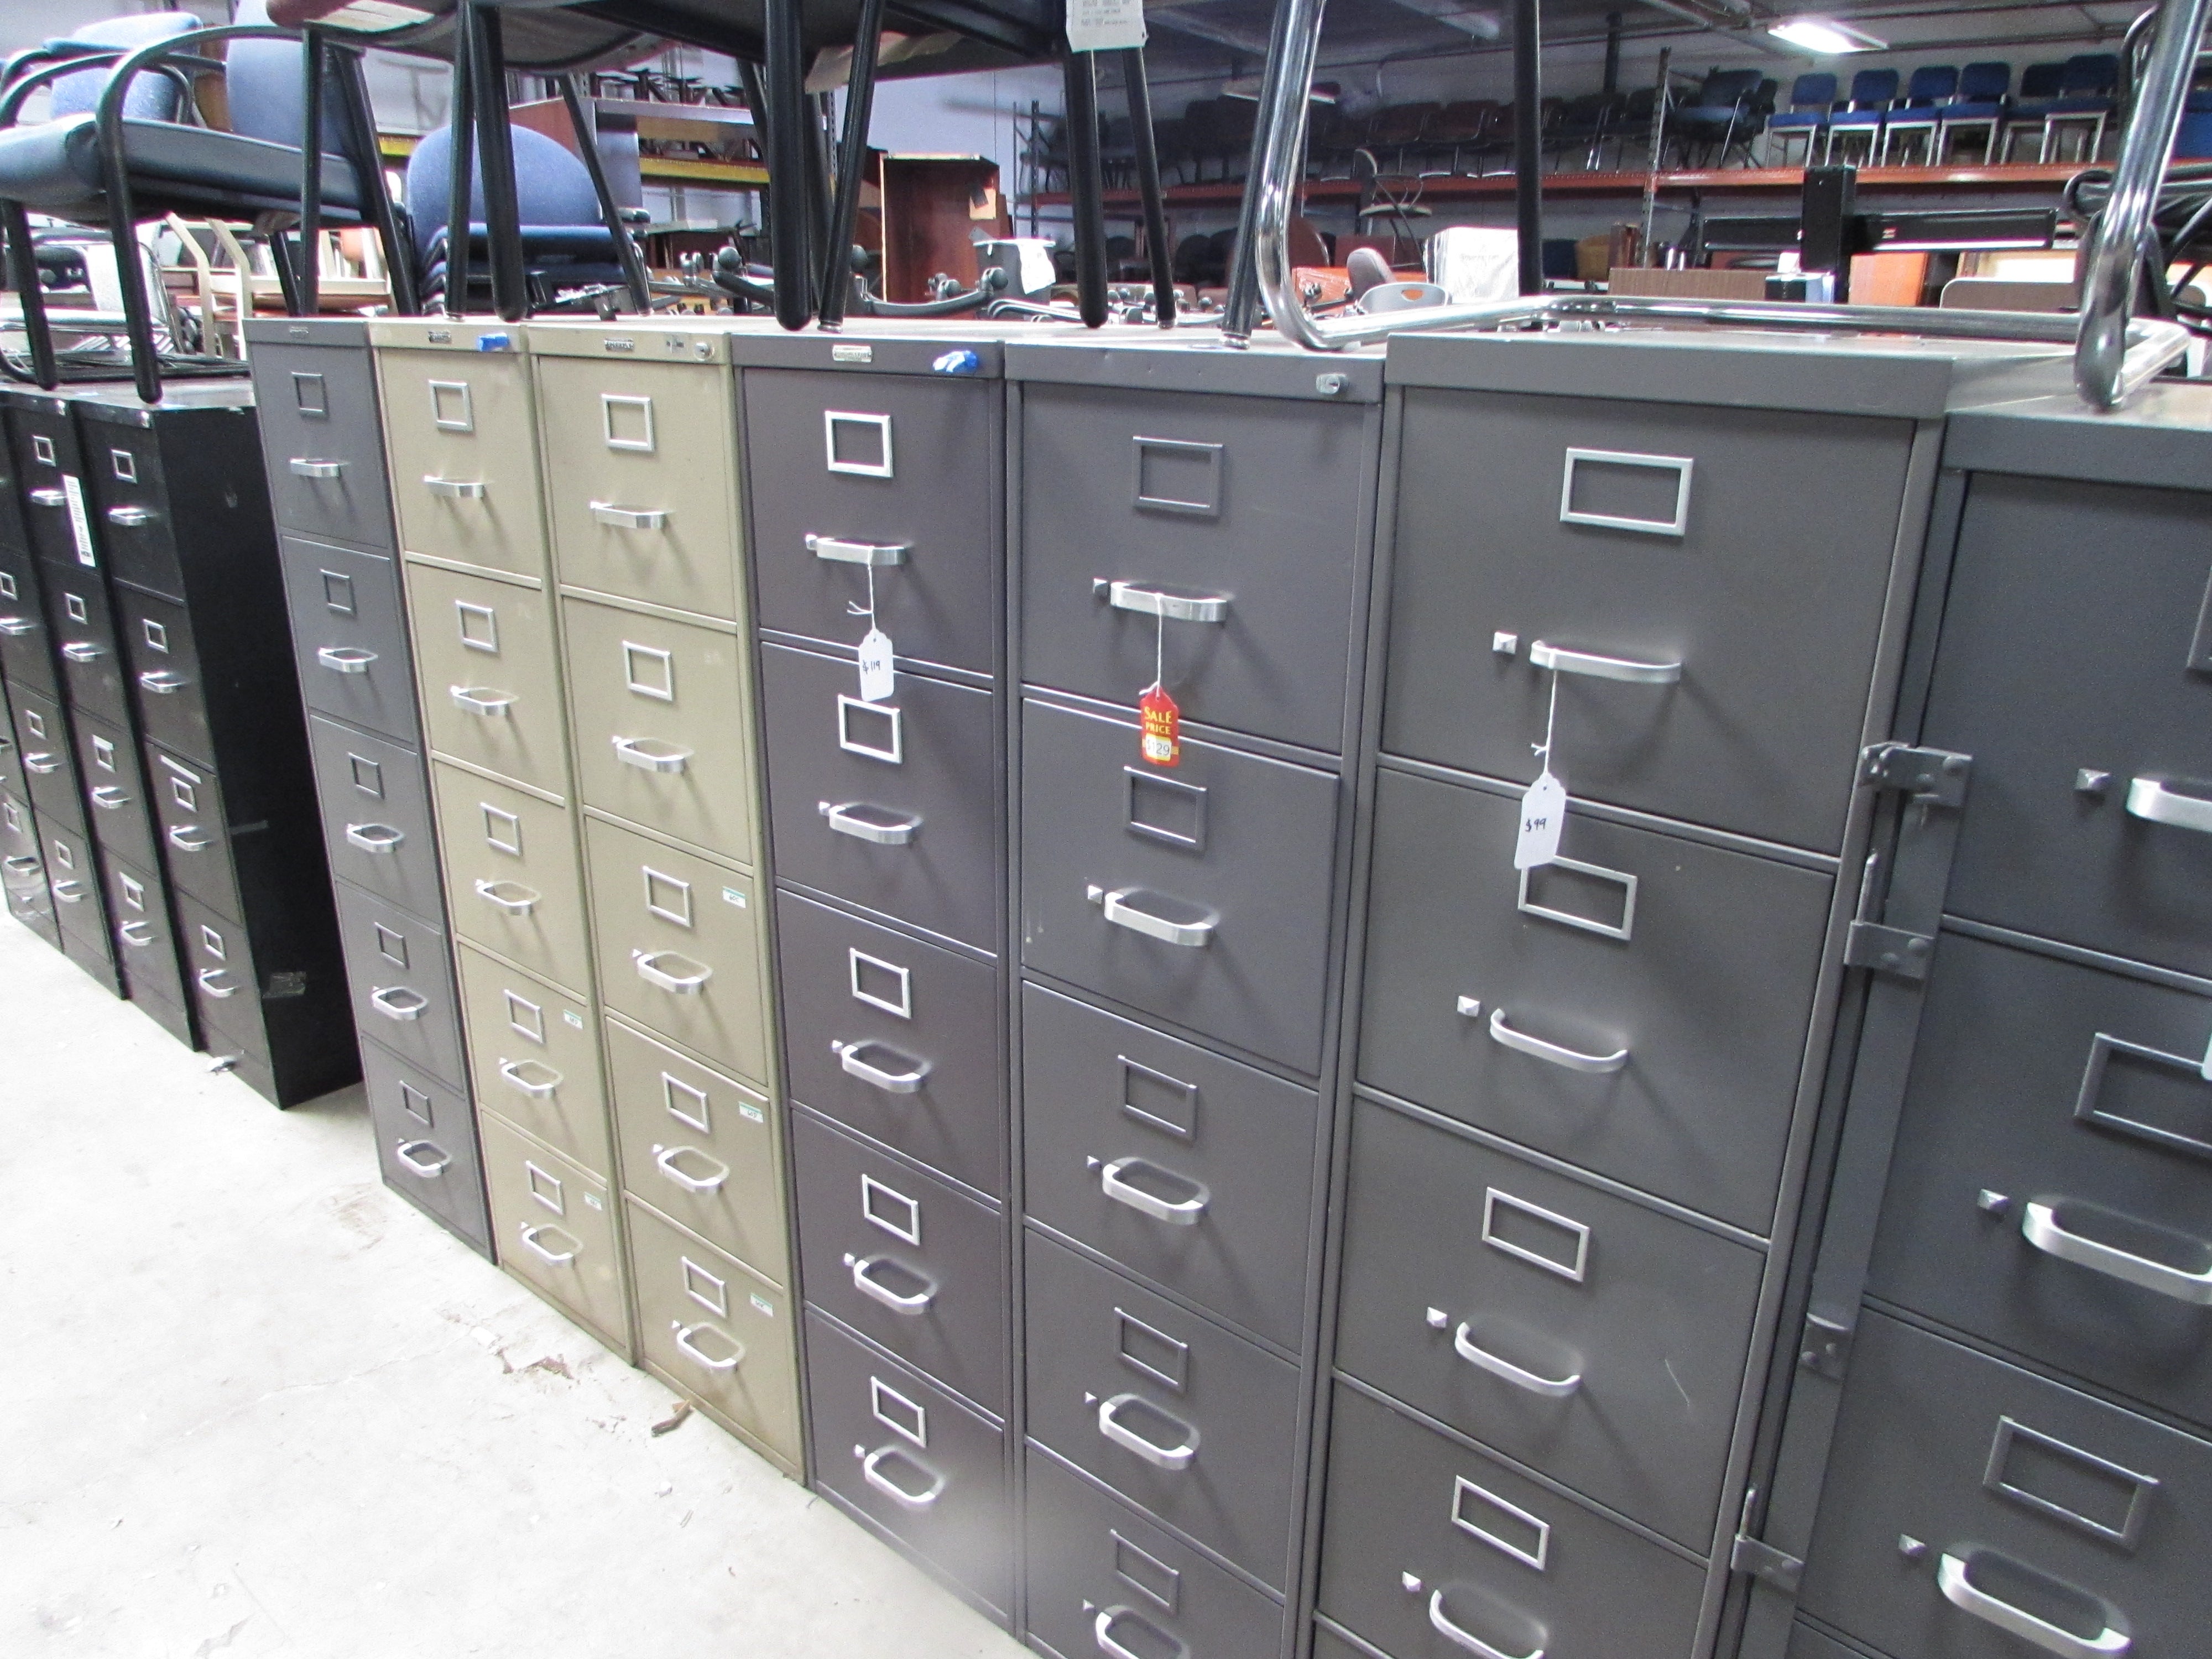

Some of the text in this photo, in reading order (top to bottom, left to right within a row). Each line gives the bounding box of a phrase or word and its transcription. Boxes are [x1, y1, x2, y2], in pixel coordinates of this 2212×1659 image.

[862, 660, 880, 675] $119
[1144, 706, 1172, 724] SALE
[1145, 722, 1171, 735] PRICE
[1147, 739, 1170, 755] $129
[1525, 818, 1547, 832] $99
